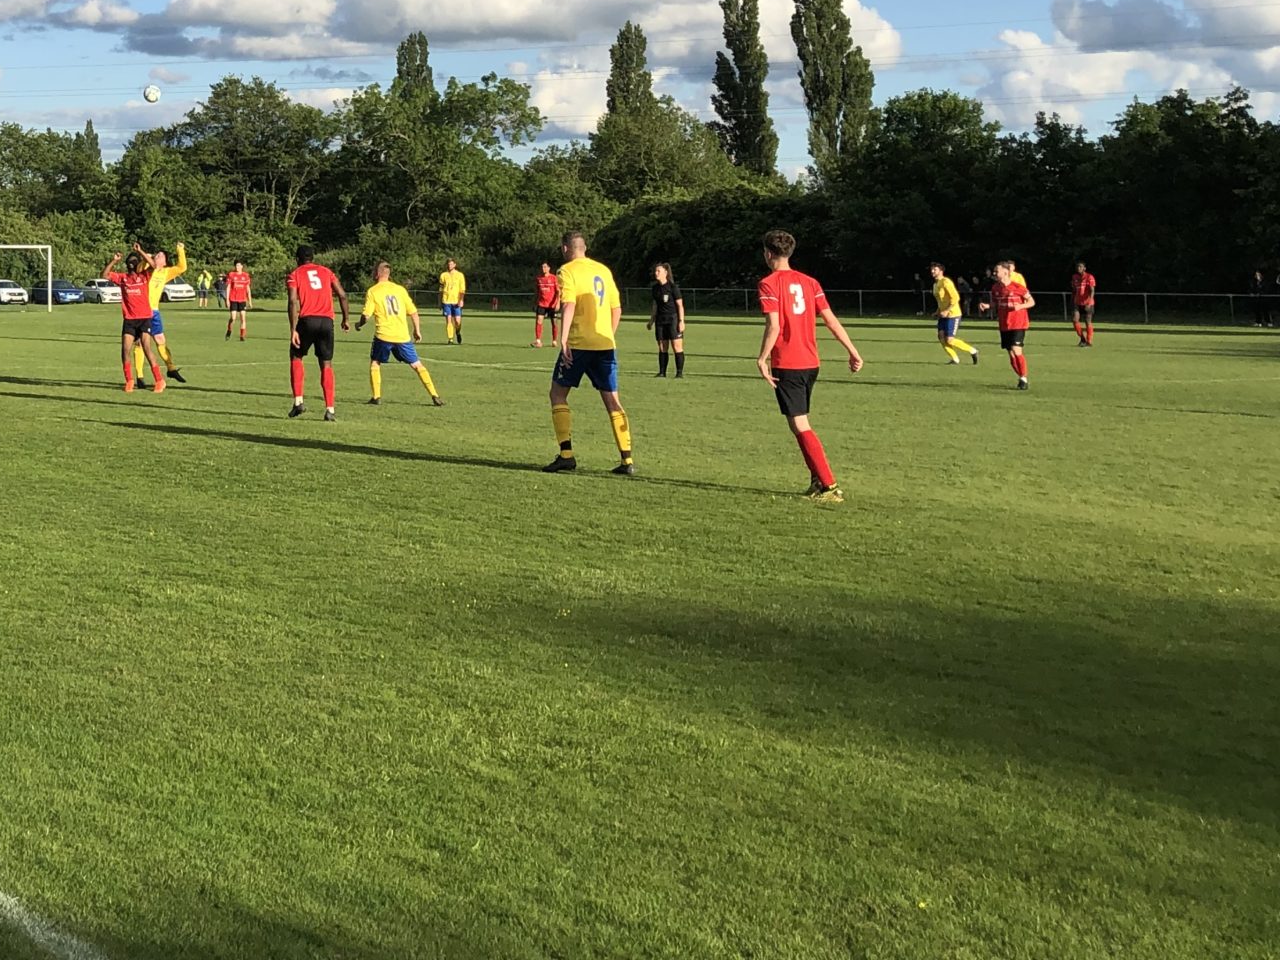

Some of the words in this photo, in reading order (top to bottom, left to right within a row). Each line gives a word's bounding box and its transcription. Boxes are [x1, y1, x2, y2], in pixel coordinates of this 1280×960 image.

[307, 270, 322, 290] 5
[593, 276, 605, 306] 9
[386, 295, 400, 315] 10
[789, 283, 805, 315] 3
